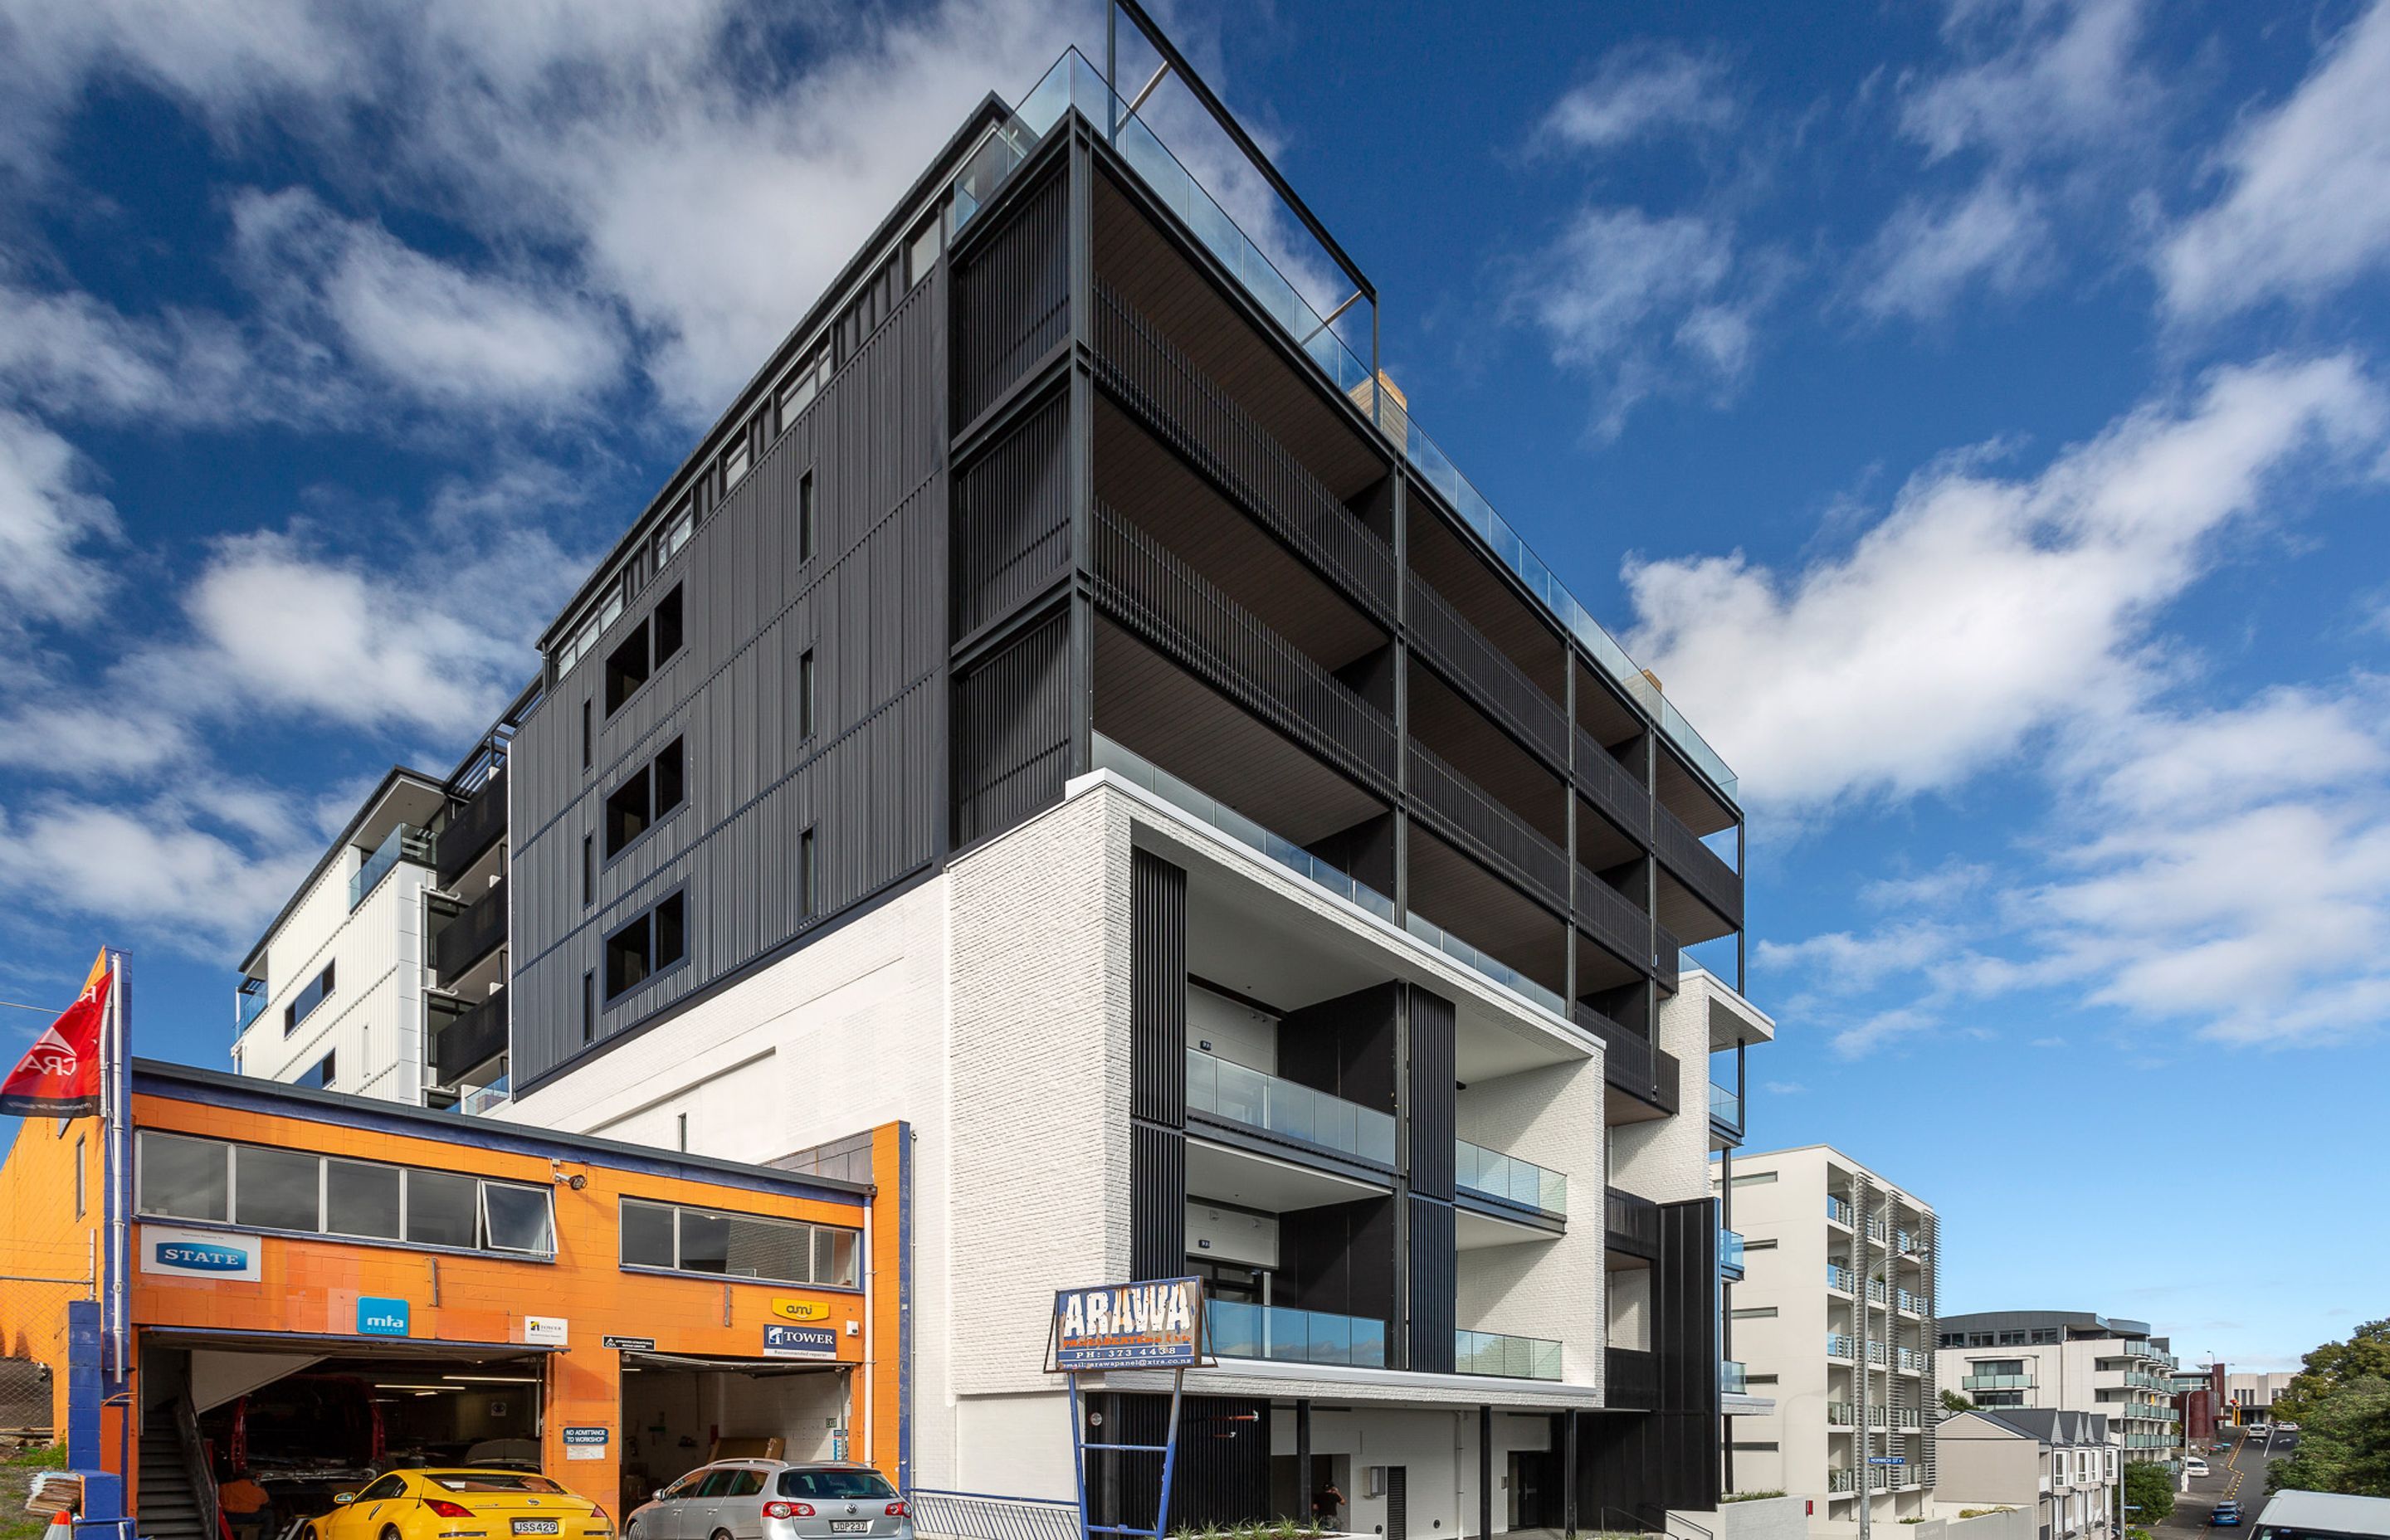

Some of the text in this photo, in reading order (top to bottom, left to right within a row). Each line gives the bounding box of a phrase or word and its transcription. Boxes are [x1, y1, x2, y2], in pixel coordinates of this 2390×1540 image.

[164, 1249, 239, 1265] STATE
[786, 1304, 812, 1315] ami
[1063, 1284, 1190, 1337] ARAWA
[367, 1315, 404, 1328] mta
[783, 1331, 833, 1344] TOWER
[1075, 1347, 1177, 1359] PH: 373 4438
[515, 1523, 556, 1532] JSS429
